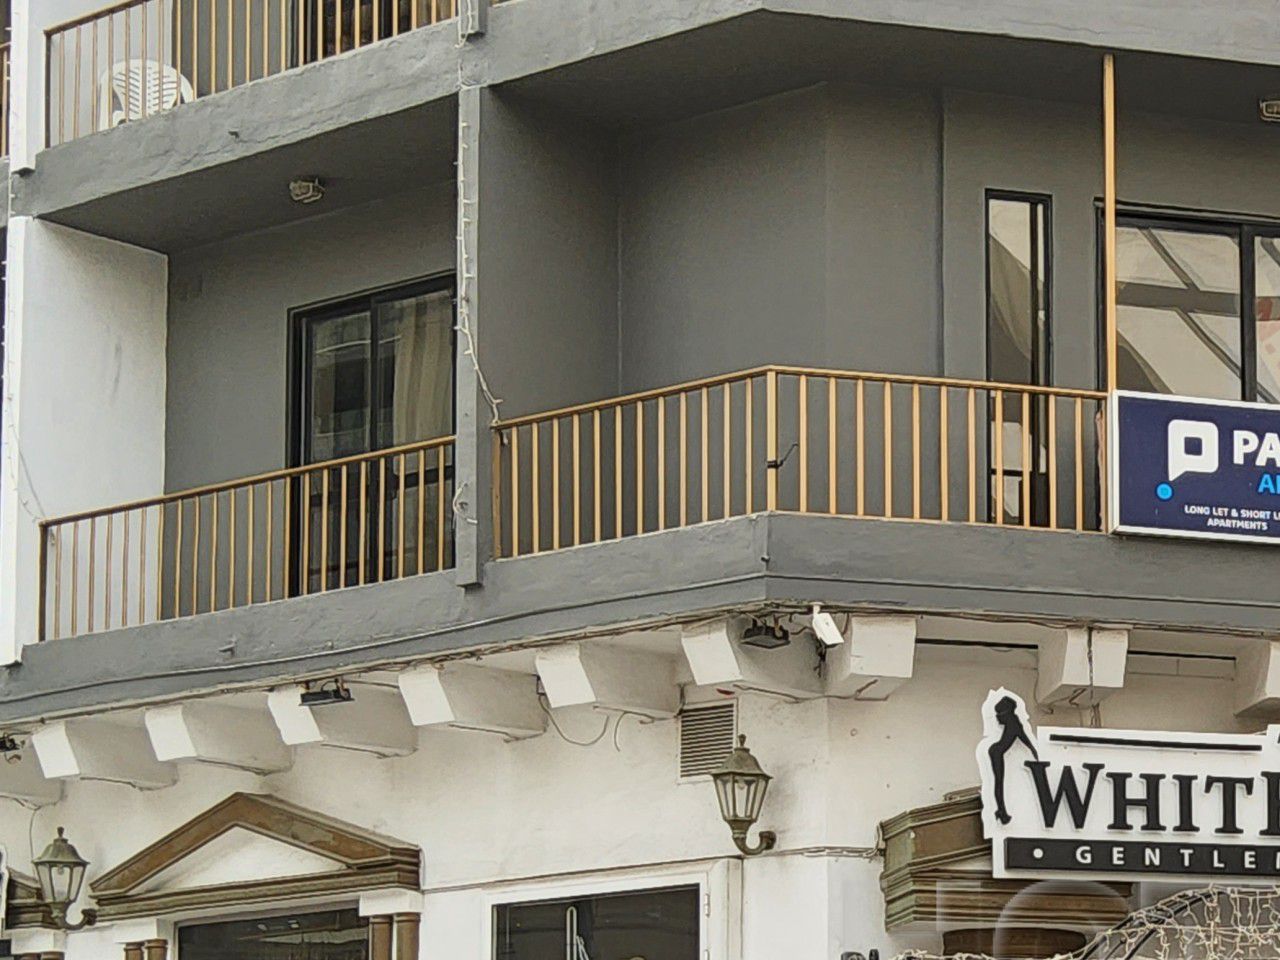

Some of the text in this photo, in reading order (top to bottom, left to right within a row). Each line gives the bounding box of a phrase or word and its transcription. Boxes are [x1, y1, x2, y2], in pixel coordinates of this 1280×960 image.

[1184, 505, 1210, 515] LONG
[1212, 507, 1229, 517] LET
[1231, 508, 1239, 517] &
[1240, 509, 1271, 520] SHORT
[1207, 518, 1268, 530] APARTMENTS
